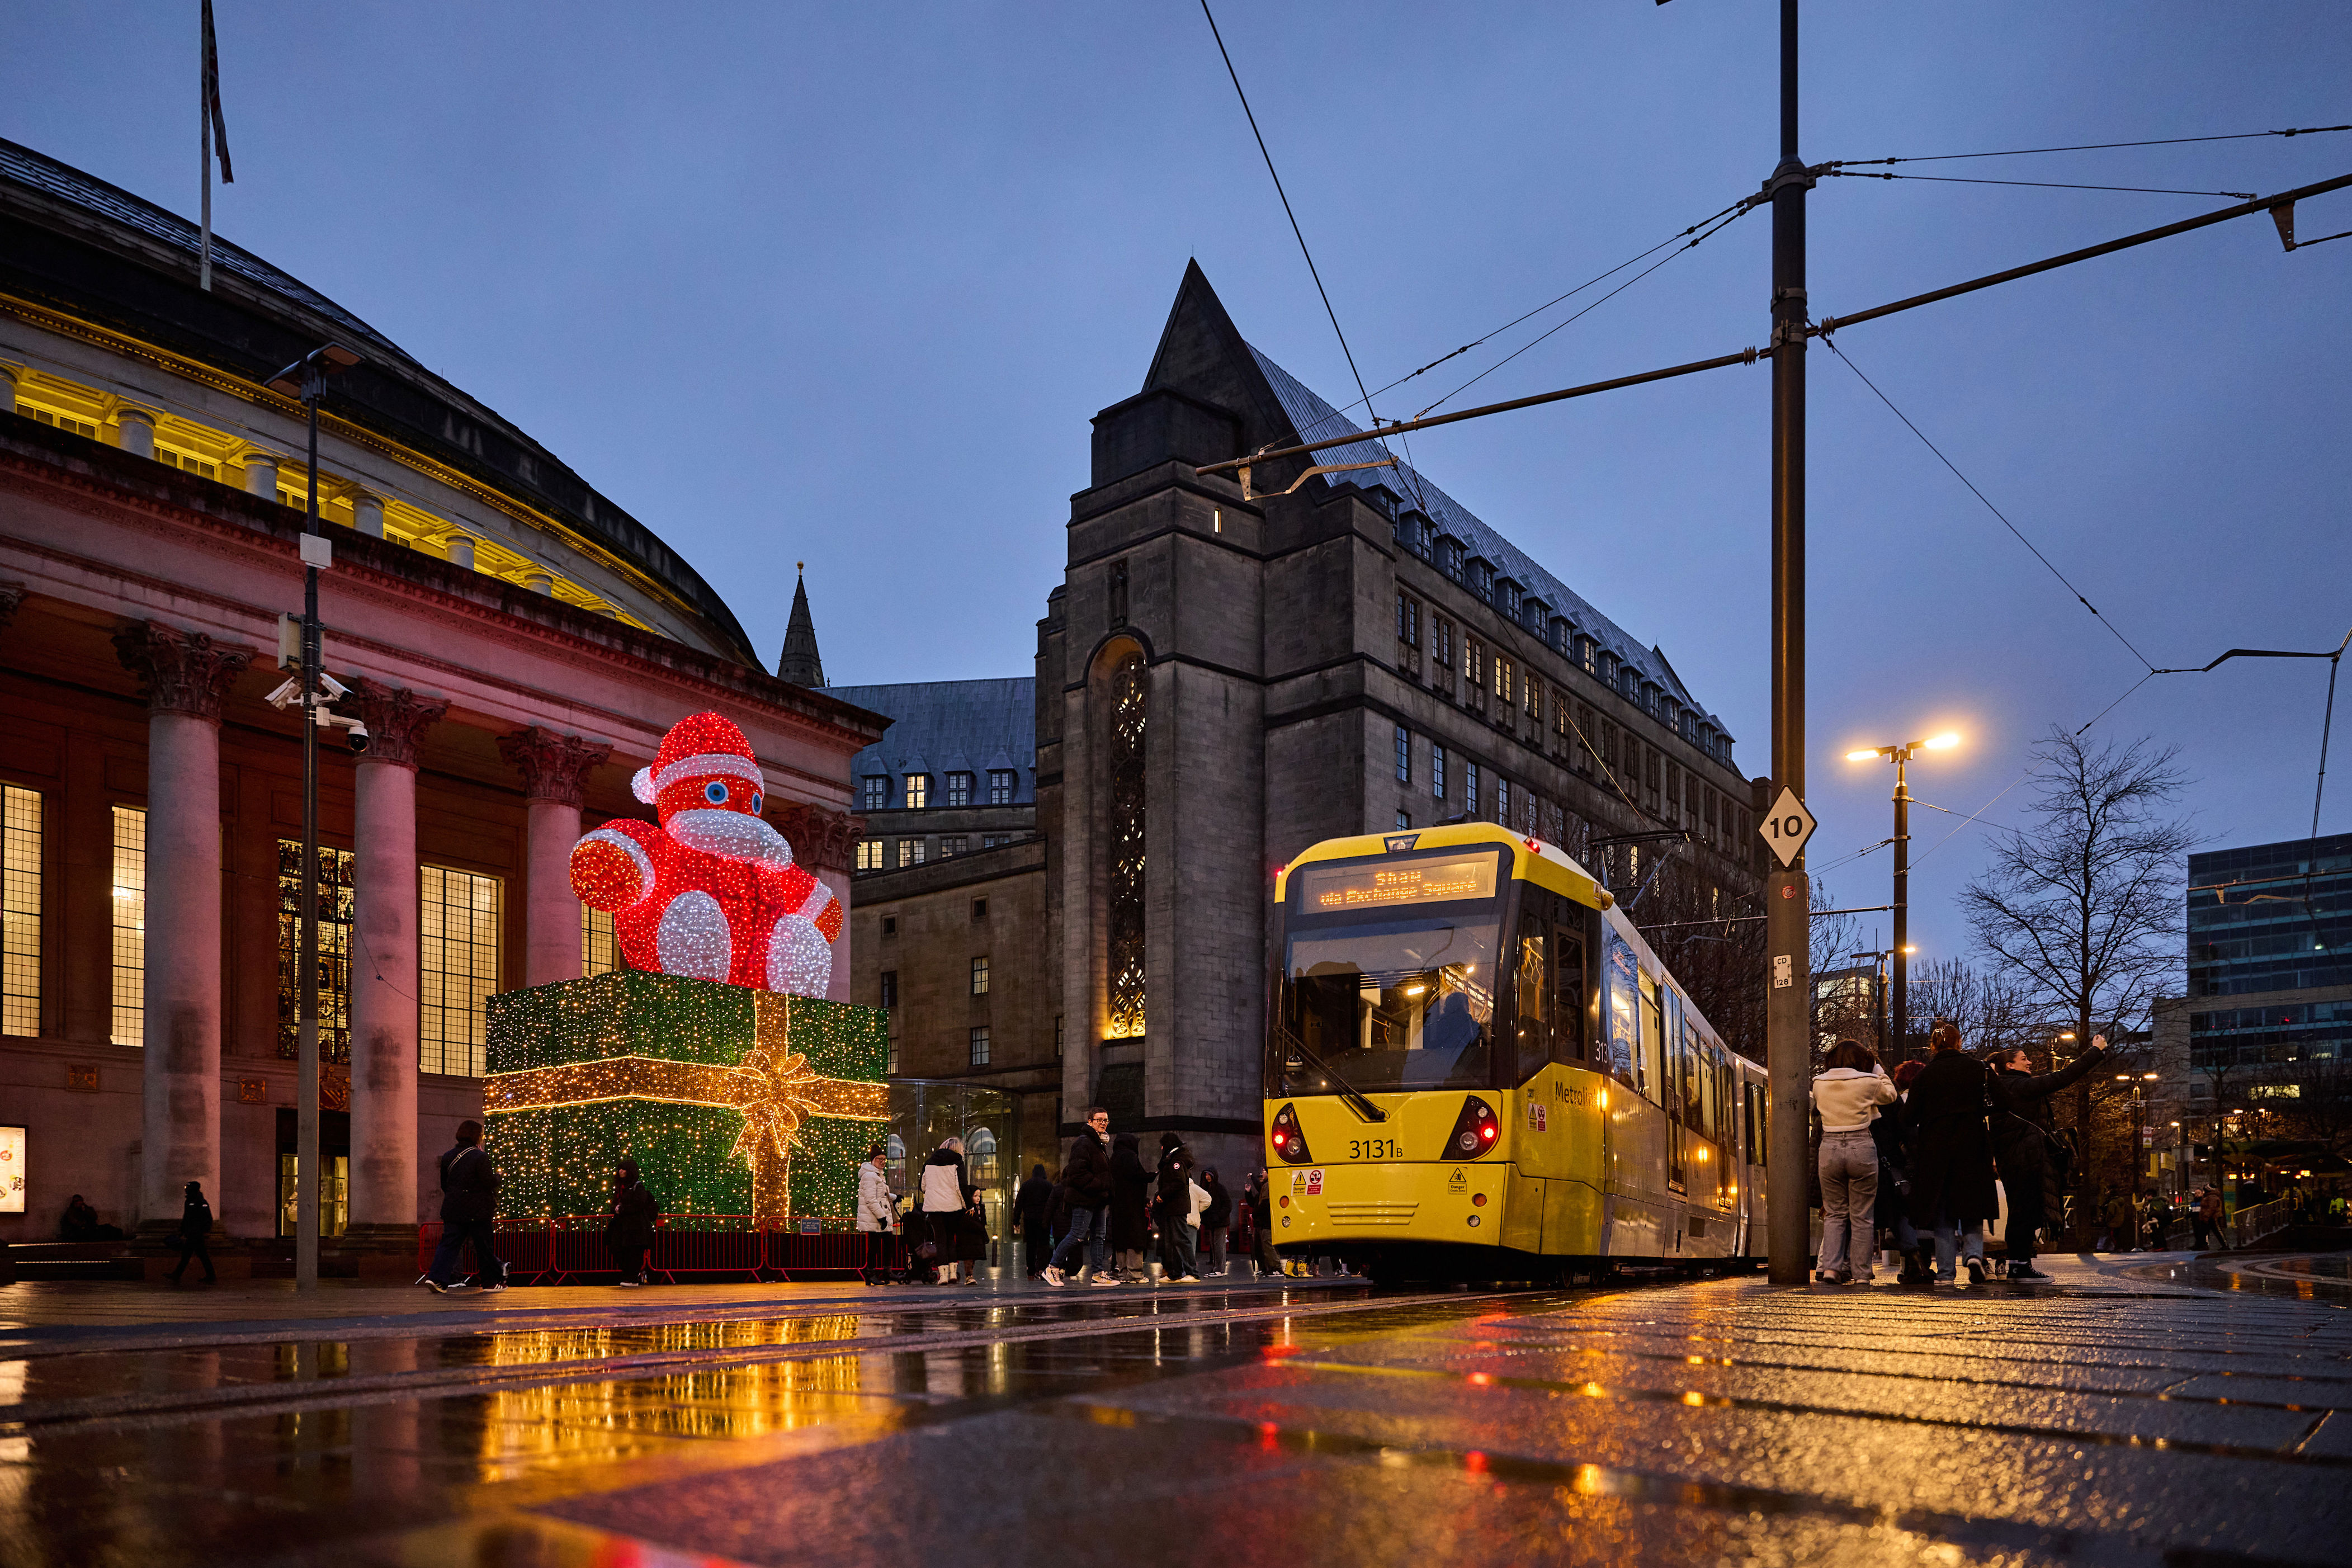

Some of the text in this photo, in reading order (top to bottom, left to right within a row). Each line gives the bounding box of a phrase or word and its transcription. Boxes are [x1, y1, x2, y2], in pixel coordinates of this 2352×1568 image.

[1770, 815, 1802, 839] 10
[1376, 871, 1421, 886] Shaw
[1321, 881, 1476, 905] via Exchange Square
